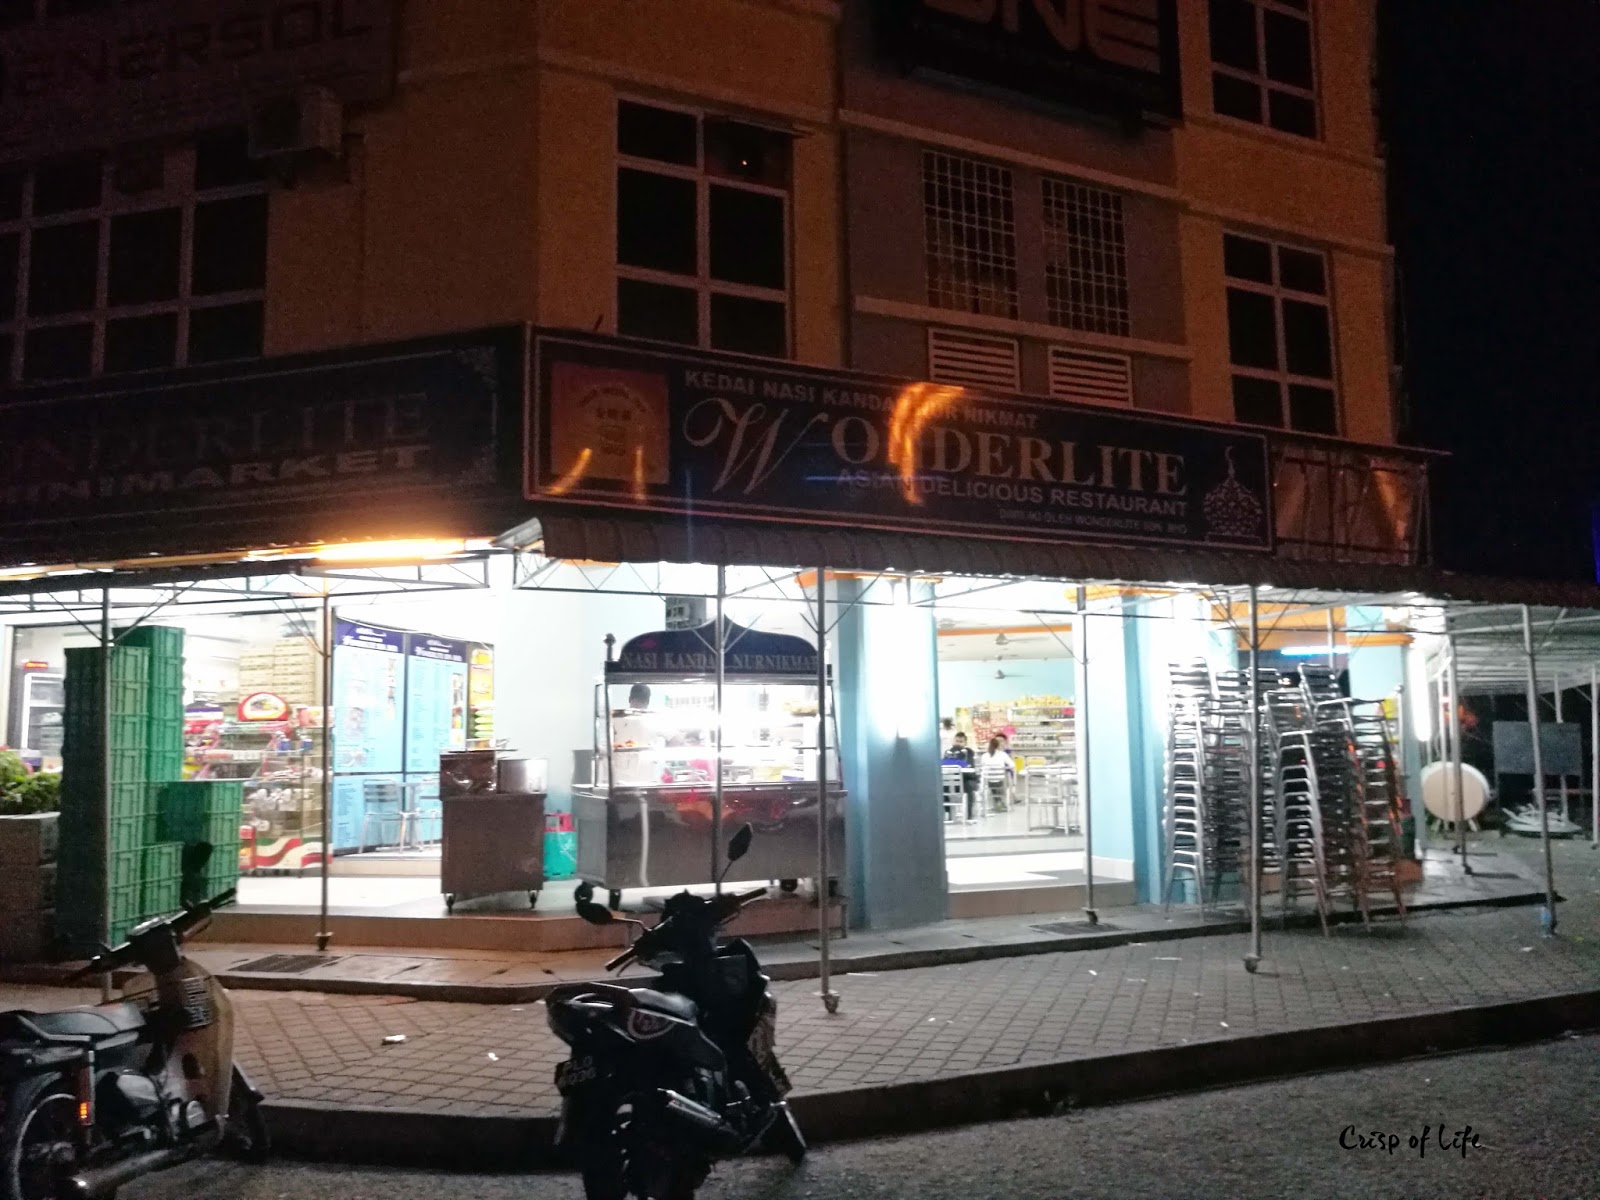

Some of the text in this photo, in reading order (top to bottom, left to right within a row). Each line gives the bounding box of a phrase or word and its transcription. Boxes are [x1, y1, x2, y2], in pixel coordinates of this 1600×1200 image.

[684, 368, 756, 396] KEDAI
[762, 380, 816, 404] NASI
[823, 387, 898, 413] KANDA
[919, 477, 1043, 504] DELICIOUS
[1050, 488, 1188, 518] RESTAURANT
[621, 652, 658, 669] NASI
[664, 652, 720, 670] KANDA
